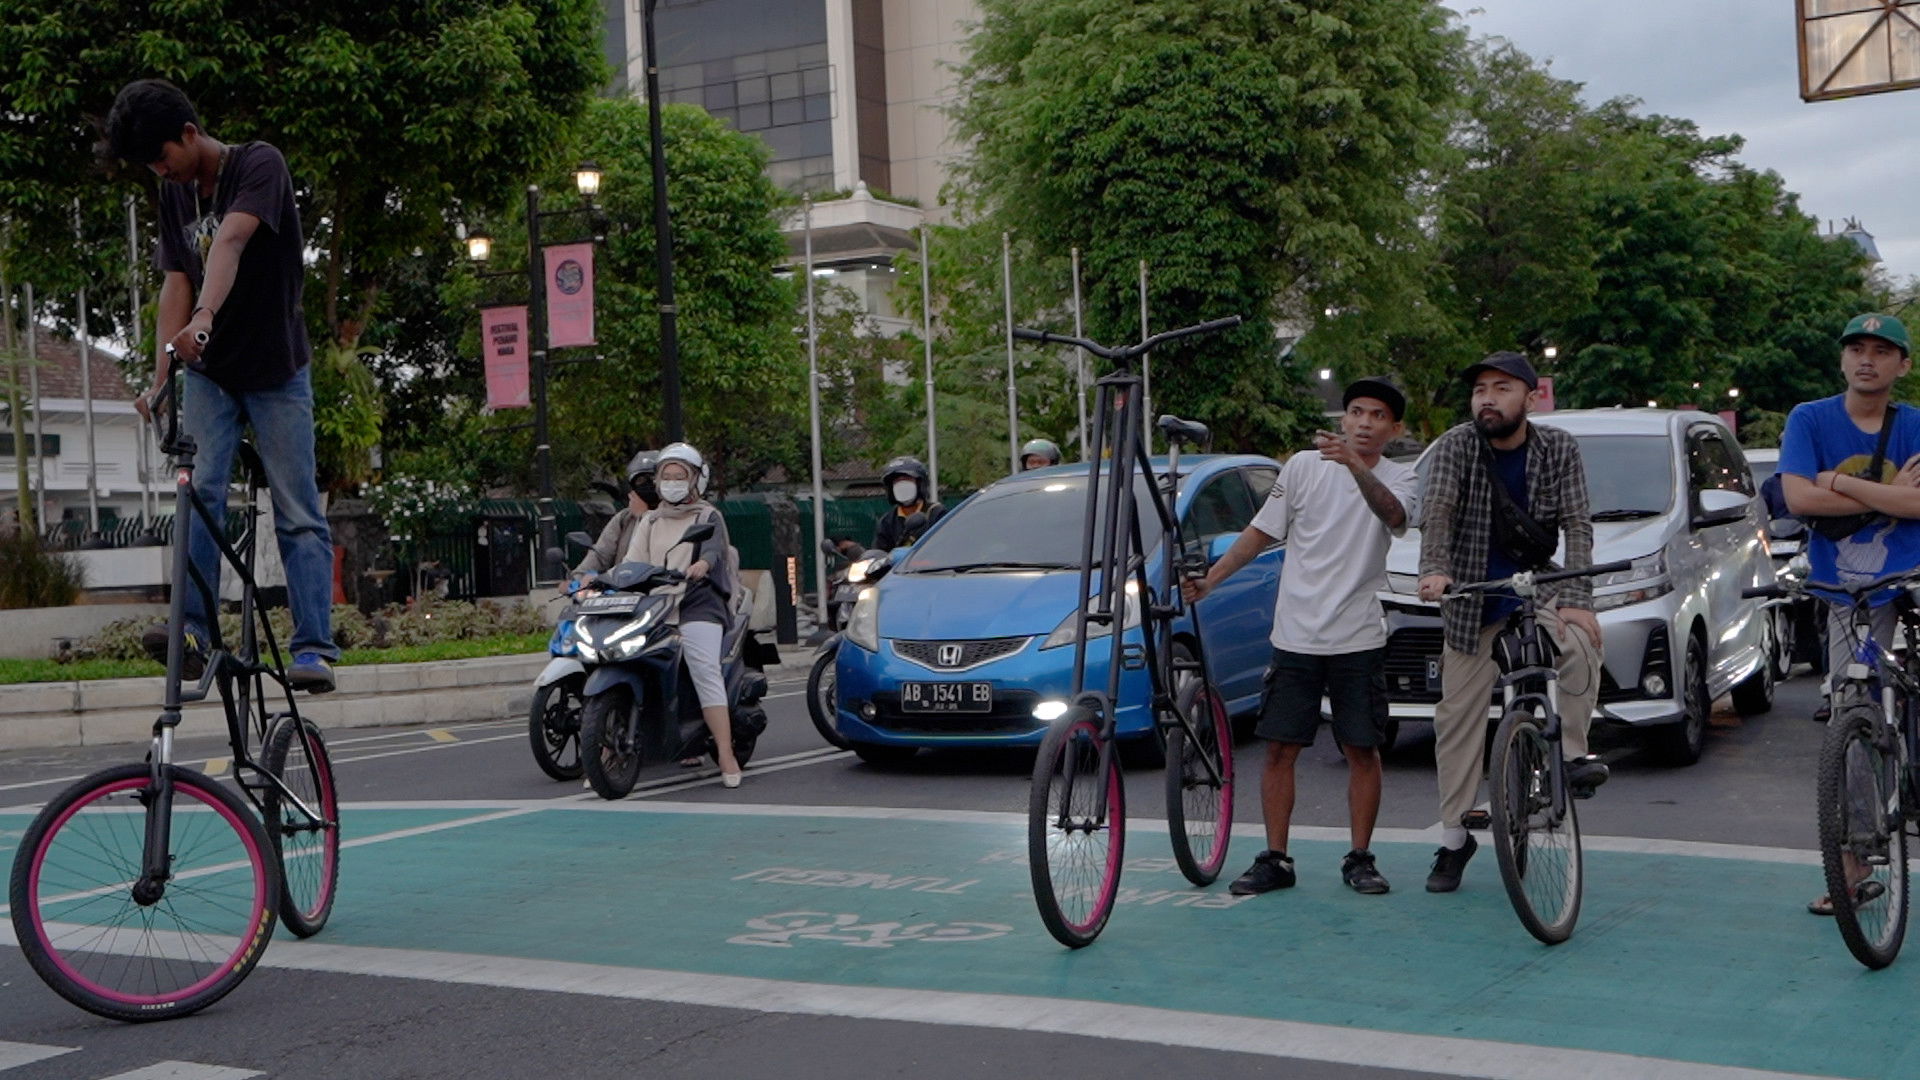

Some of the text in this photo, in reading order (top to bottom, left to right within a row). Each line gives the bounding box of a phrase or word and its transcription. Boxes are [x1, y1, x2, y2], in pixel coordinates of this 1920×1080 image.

[904, 684, 989, 702] AB 1541 EB
